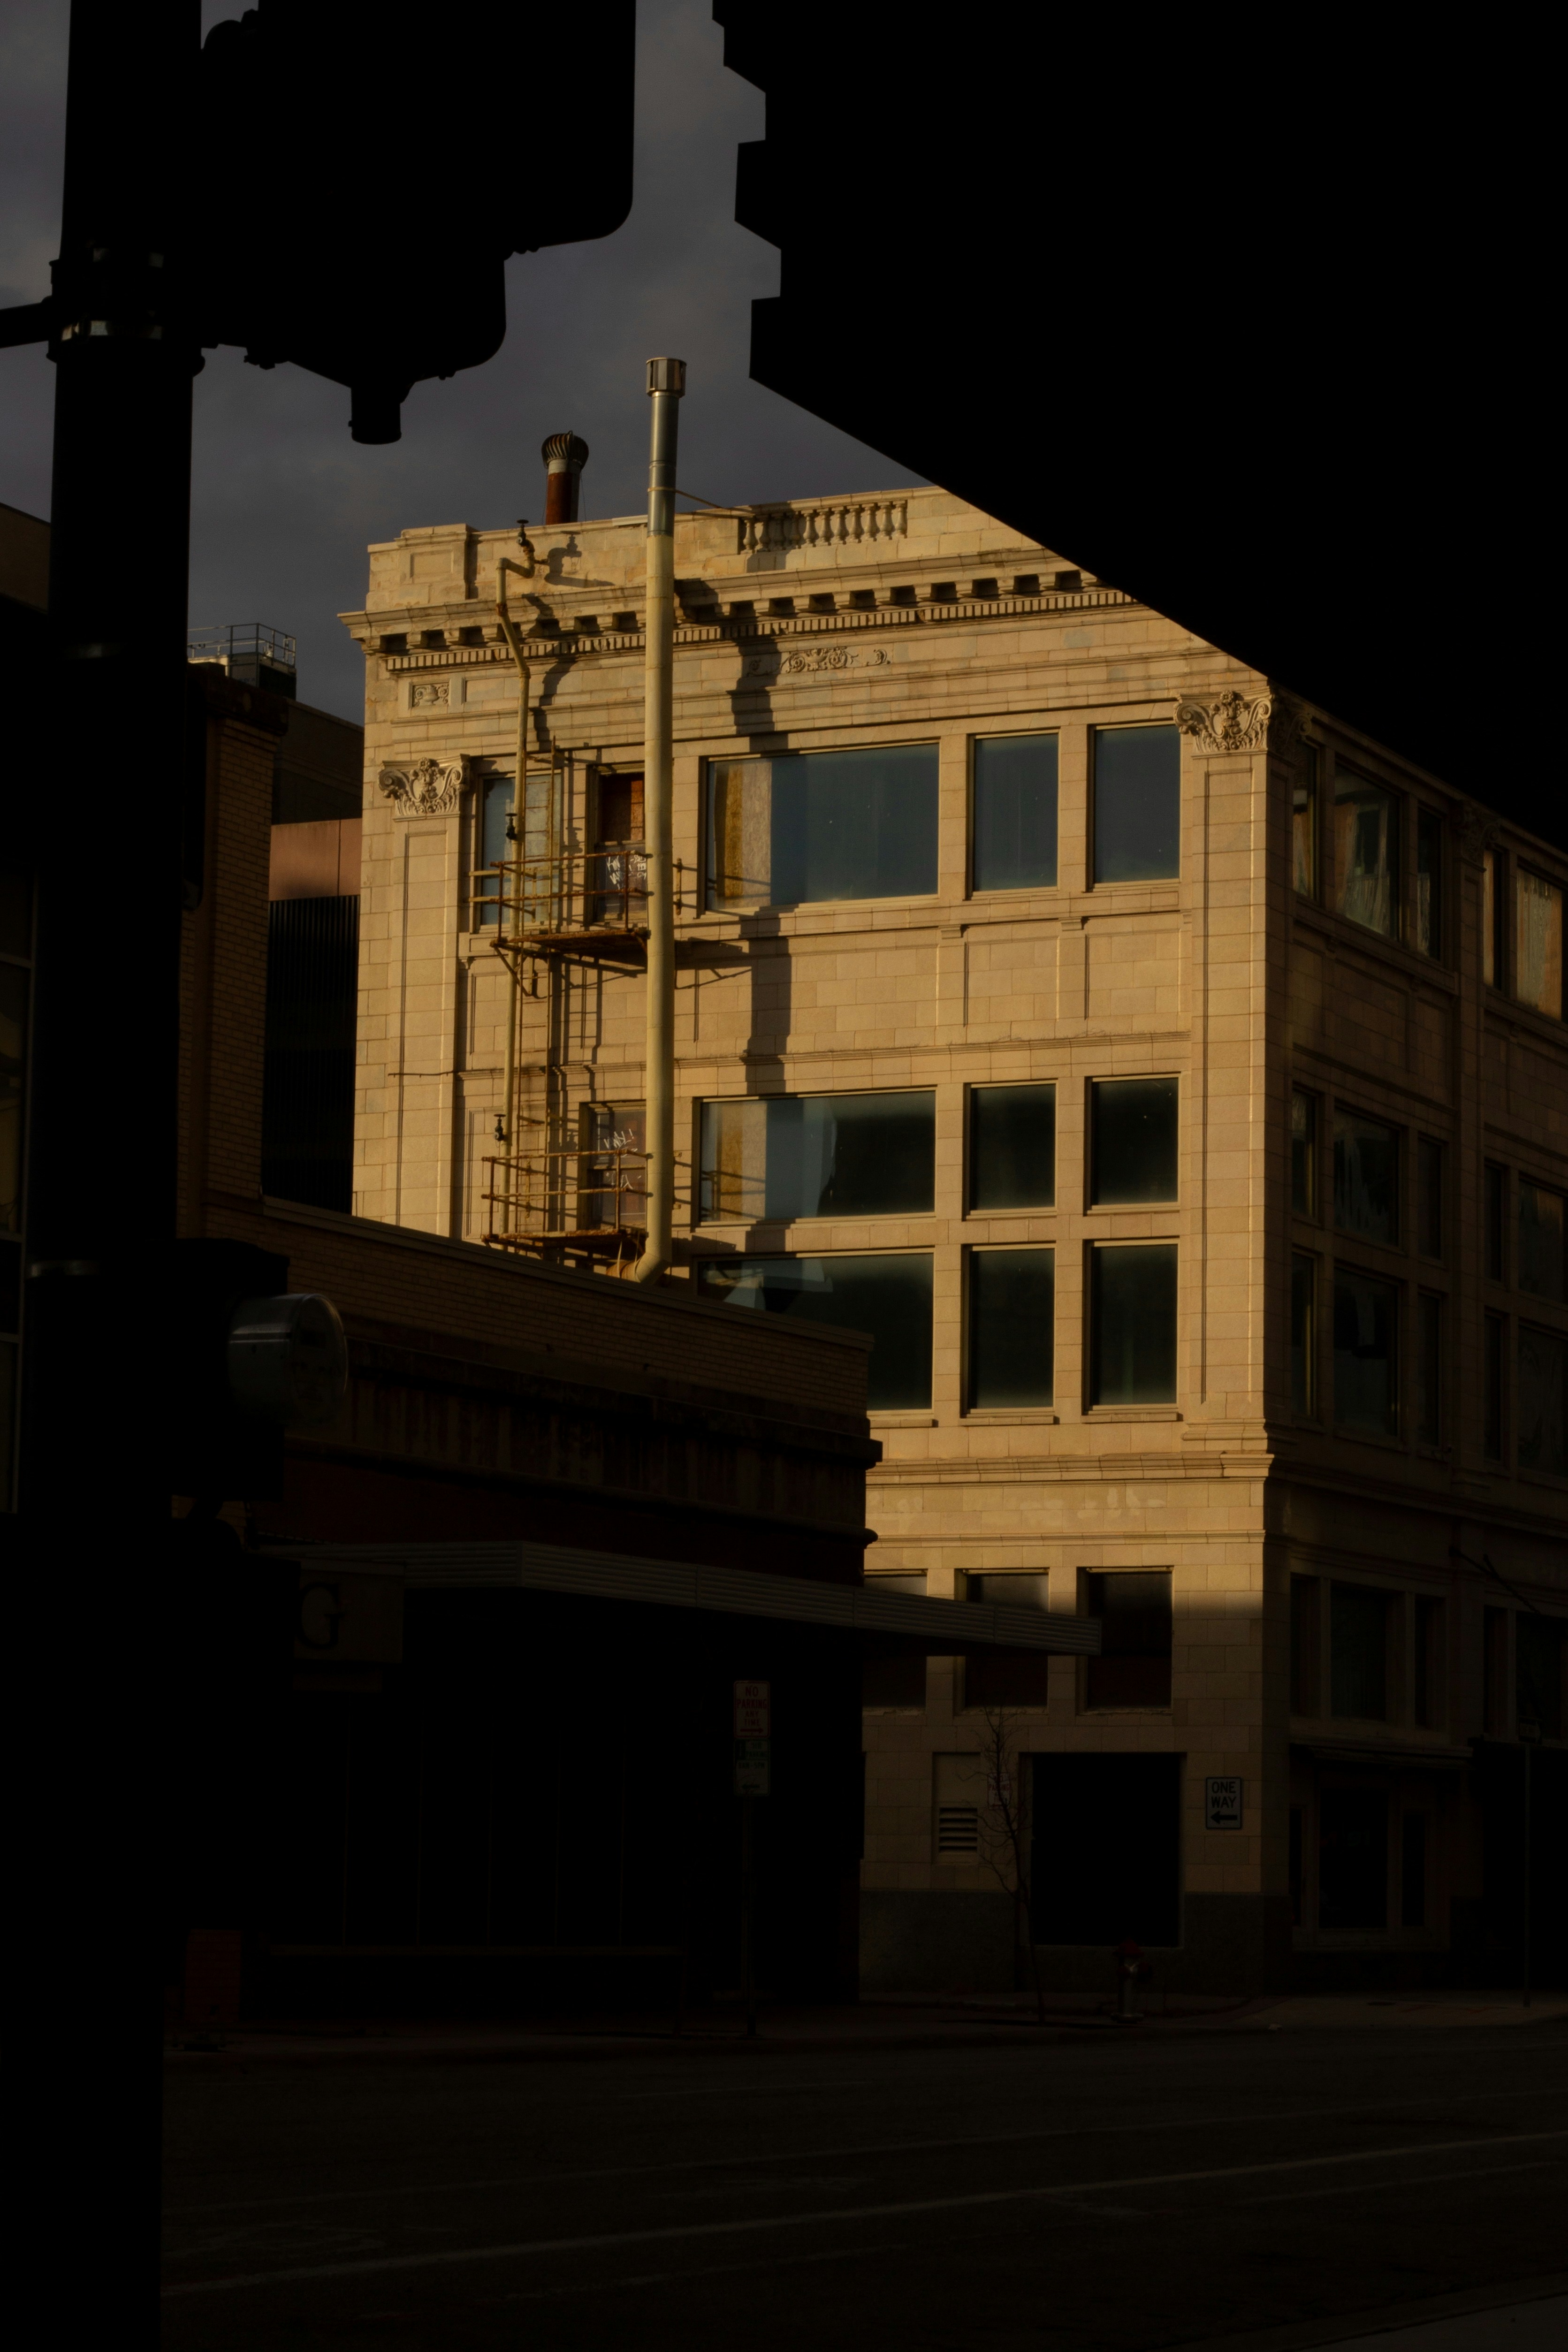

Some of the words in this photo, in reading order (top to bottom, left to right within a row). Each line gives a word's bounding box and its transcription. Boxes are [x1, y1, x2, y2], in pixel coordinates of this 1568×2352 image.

[745, 1687, 758, 1697] NO
[737, 1698, 767, 1709] PARKING
[1212, 1781, 1236, 1793] ONE
[1211, 1796, 1236, 1808] WAY
